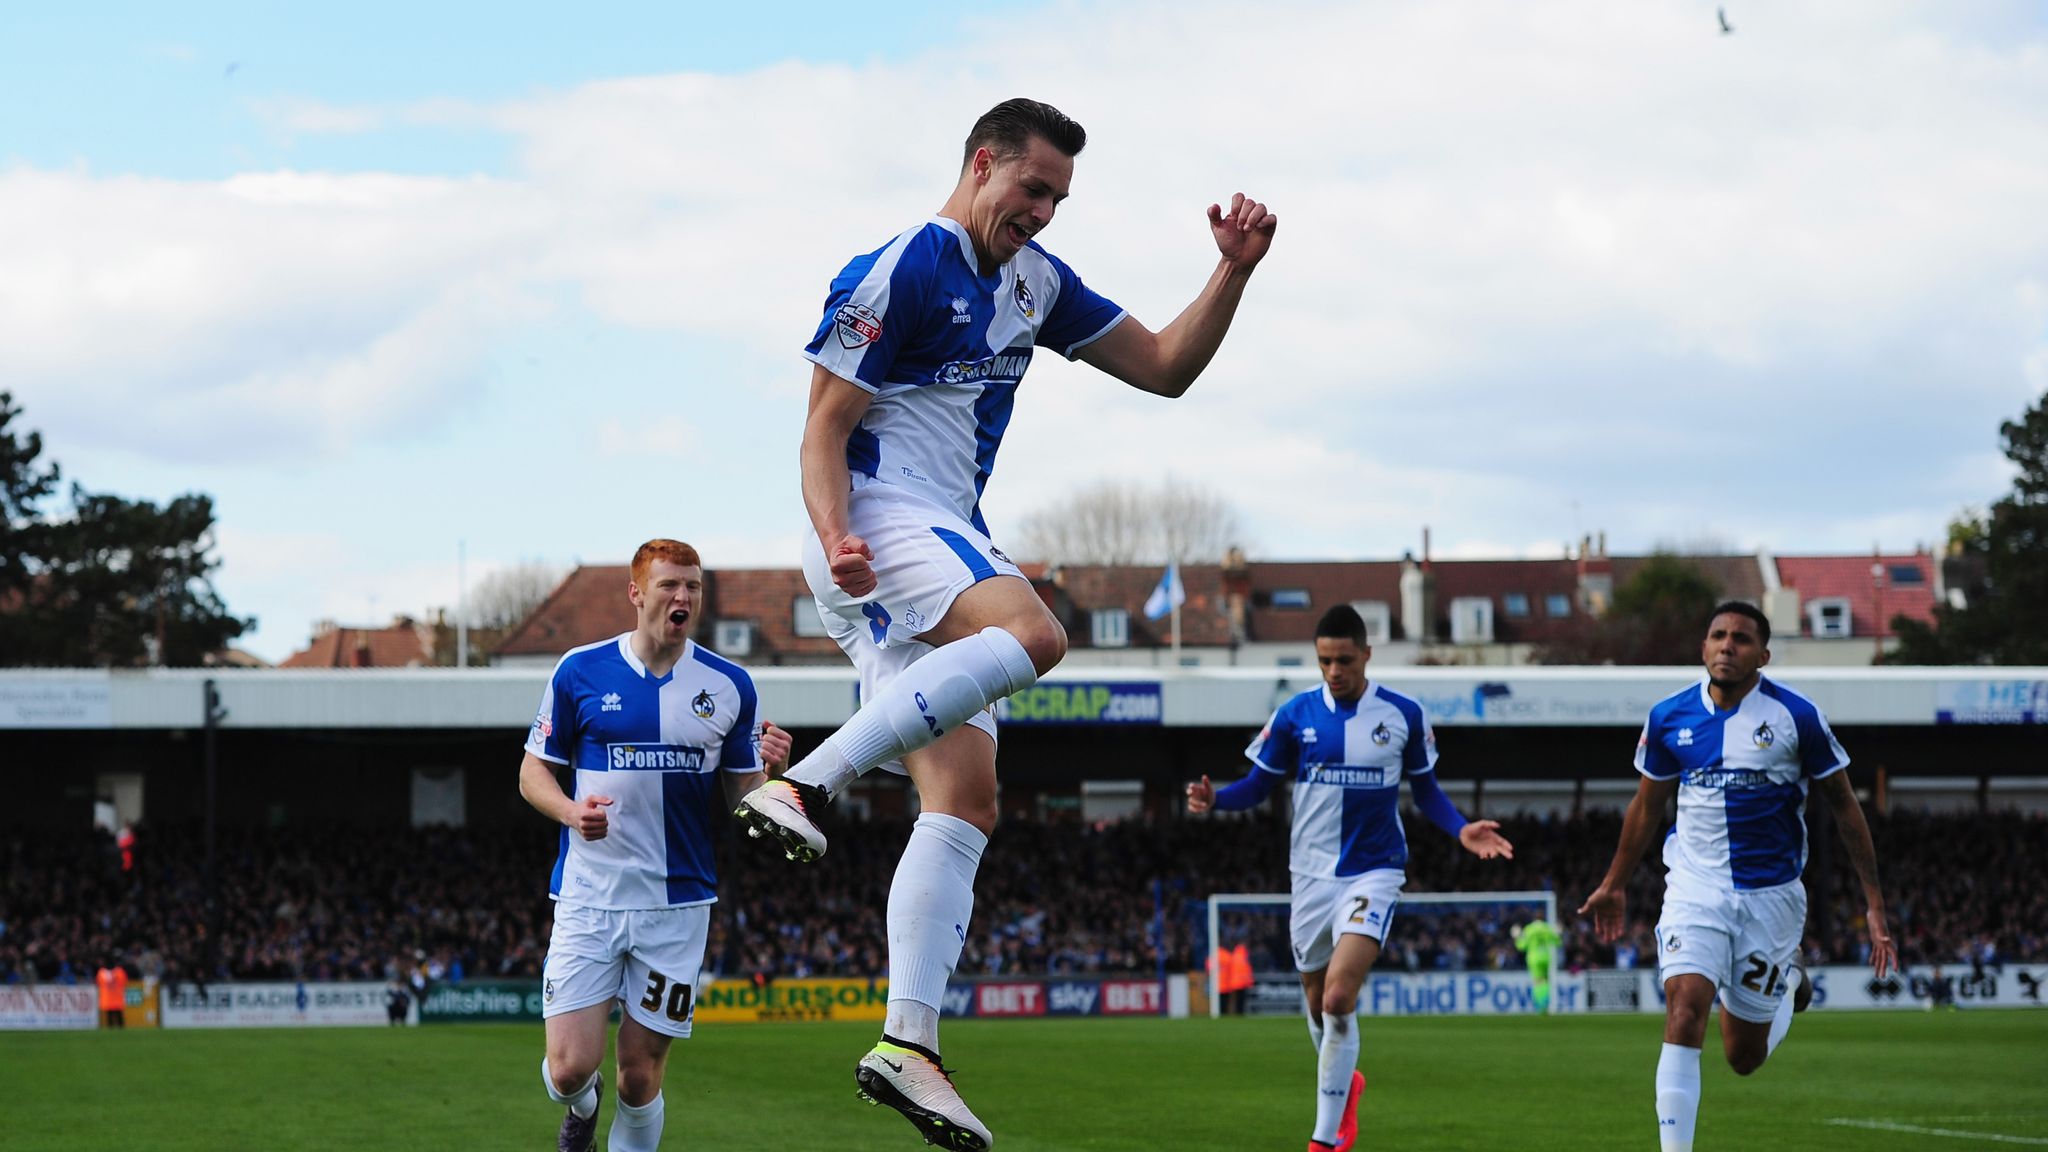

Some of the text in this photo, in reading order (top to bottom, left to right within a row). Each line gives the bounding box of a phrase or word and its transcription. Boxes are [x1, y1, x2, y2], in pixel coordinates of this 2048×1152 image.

[836, 311, 879, 338] sky BET
[1348, 896, 1369, 923] 2
[315, 990, 393, 1008] BRISTO
[423, 986, 521, 1014] wiltshire
[640, 970, 692, 1022] 30
[981, 984, 1040, 1013] BET
[1051, 984, 1098, 1015] sky
[1106, 984, 1161, 1012] BET
[1373, 975, 1455, 1013] Fluid
